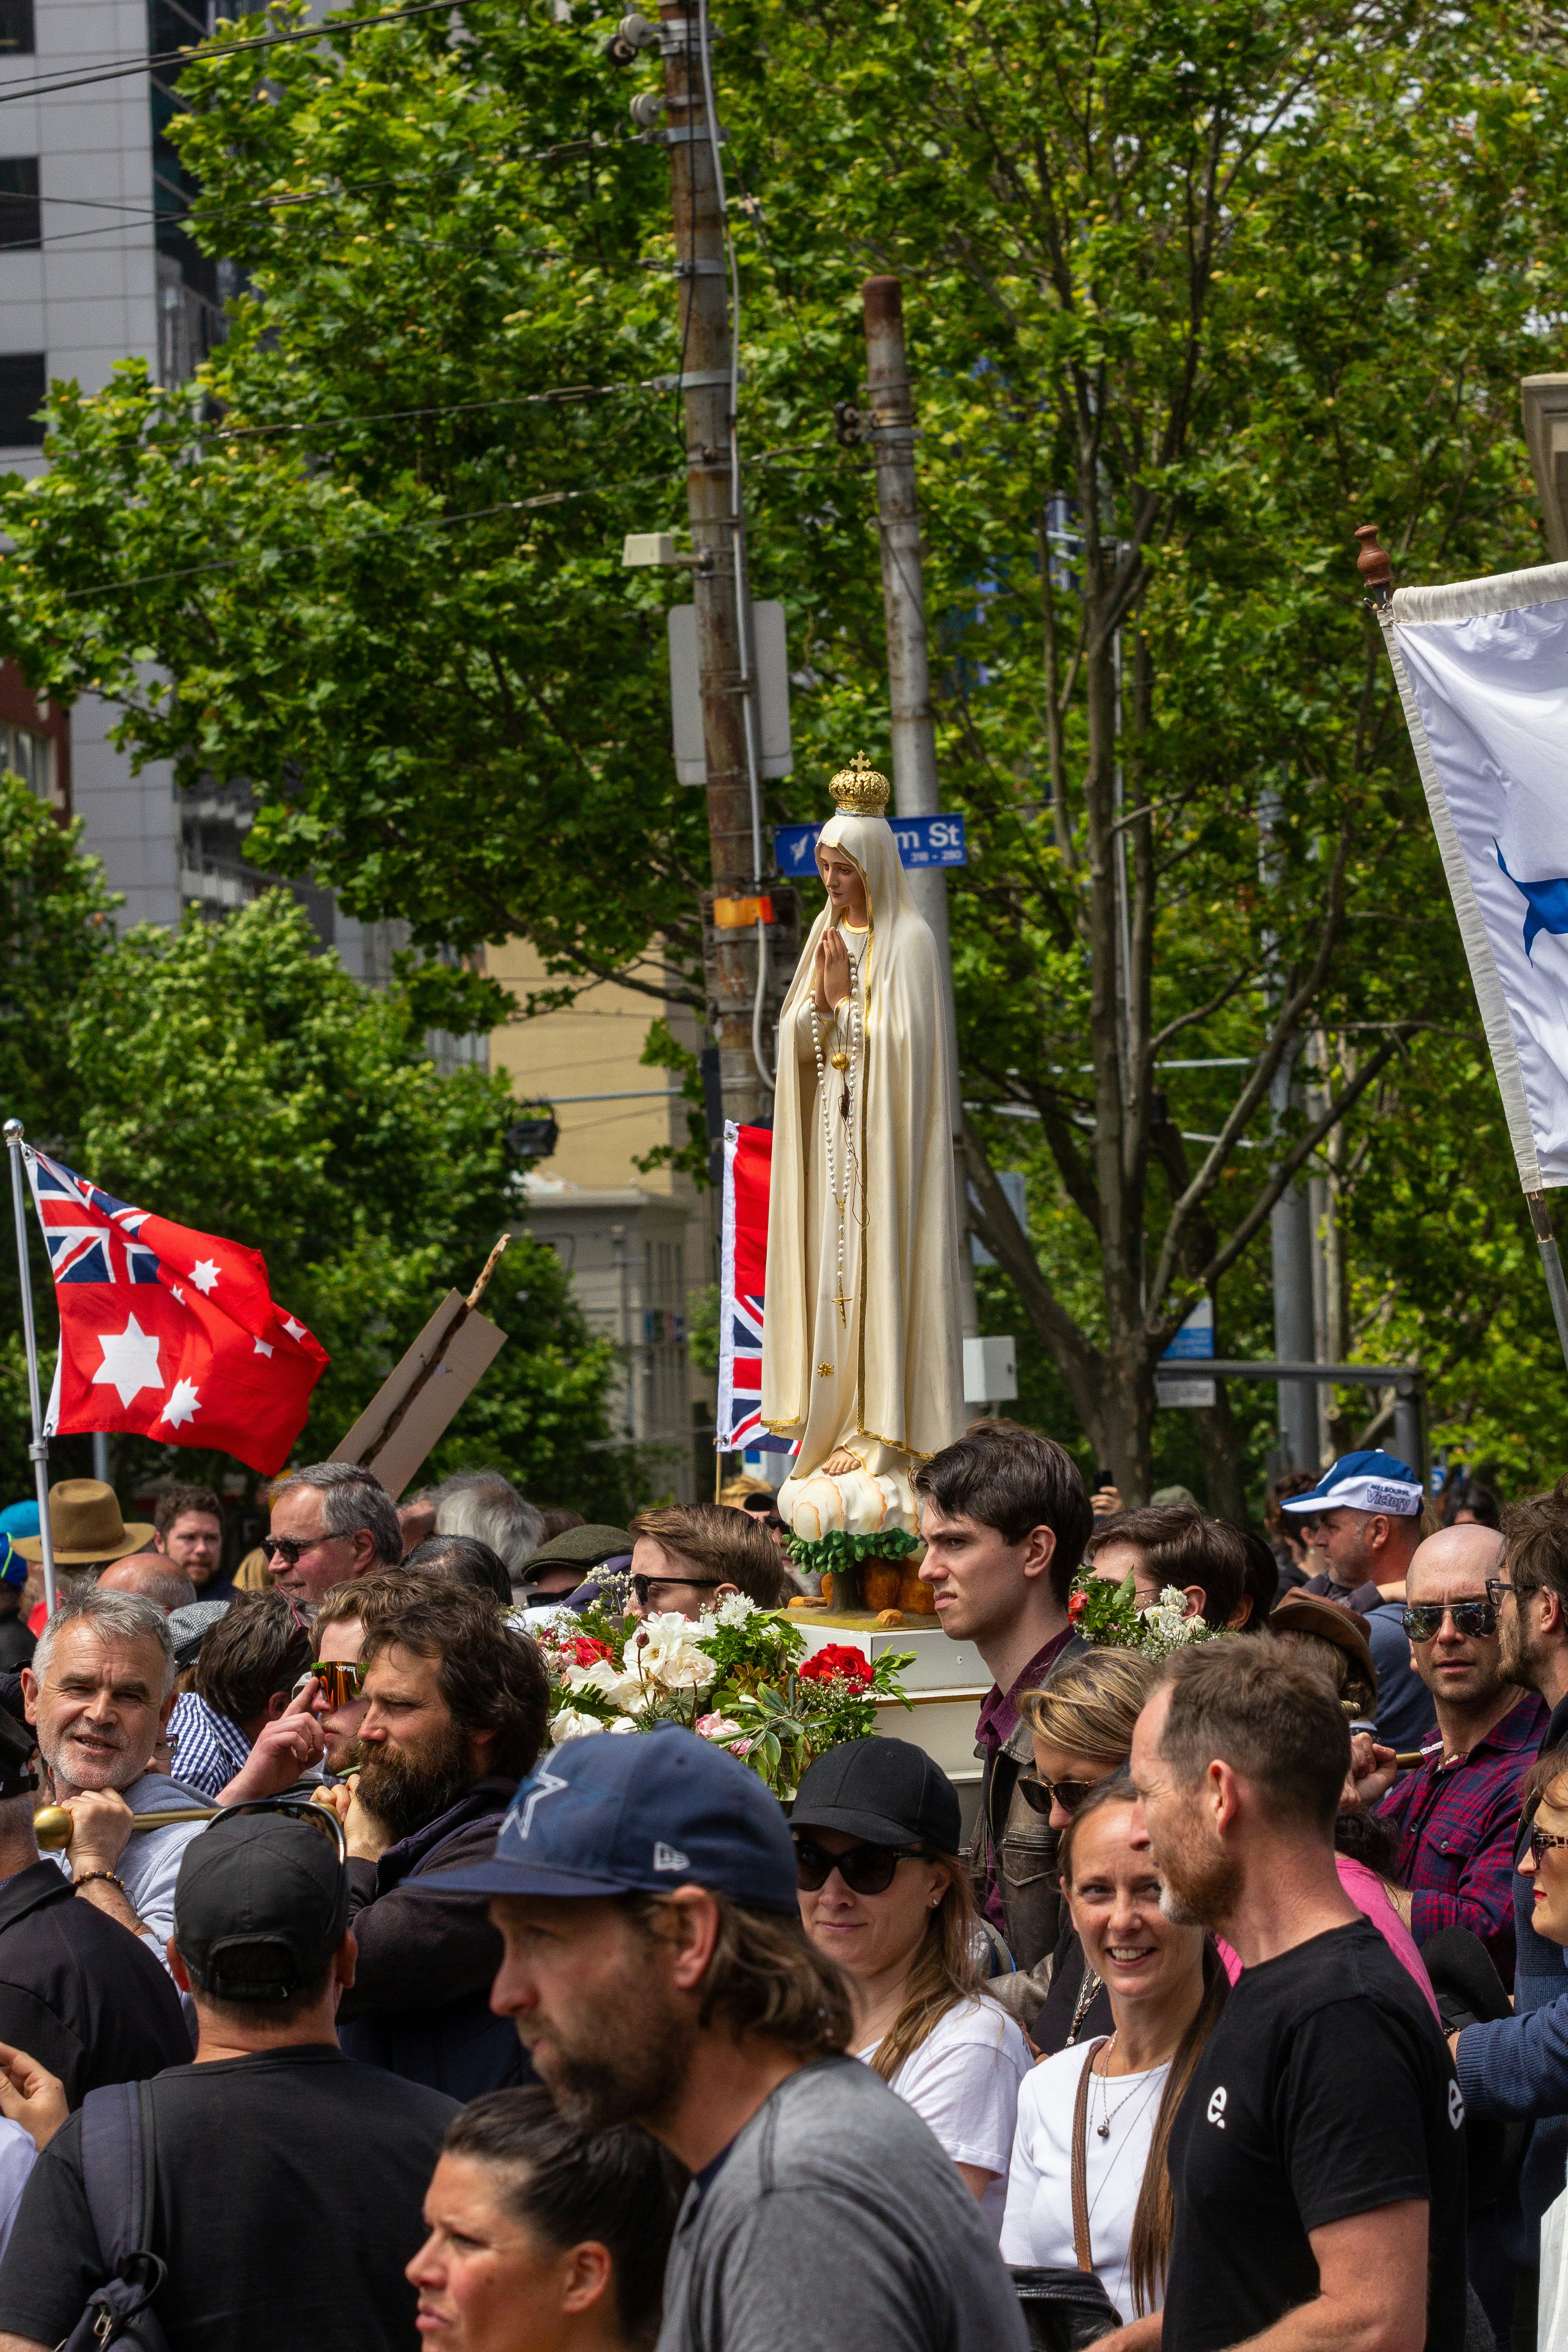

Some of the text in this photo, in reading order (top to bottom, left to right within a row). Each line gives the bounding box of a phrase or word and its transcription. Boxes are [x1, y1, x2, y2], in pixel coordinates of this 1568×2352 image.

[929, 822, 960, 847] St
[1367, 1489, 1411, 1512] Victory
[1371, 1485, 1410, 1496] MELBOURNE
